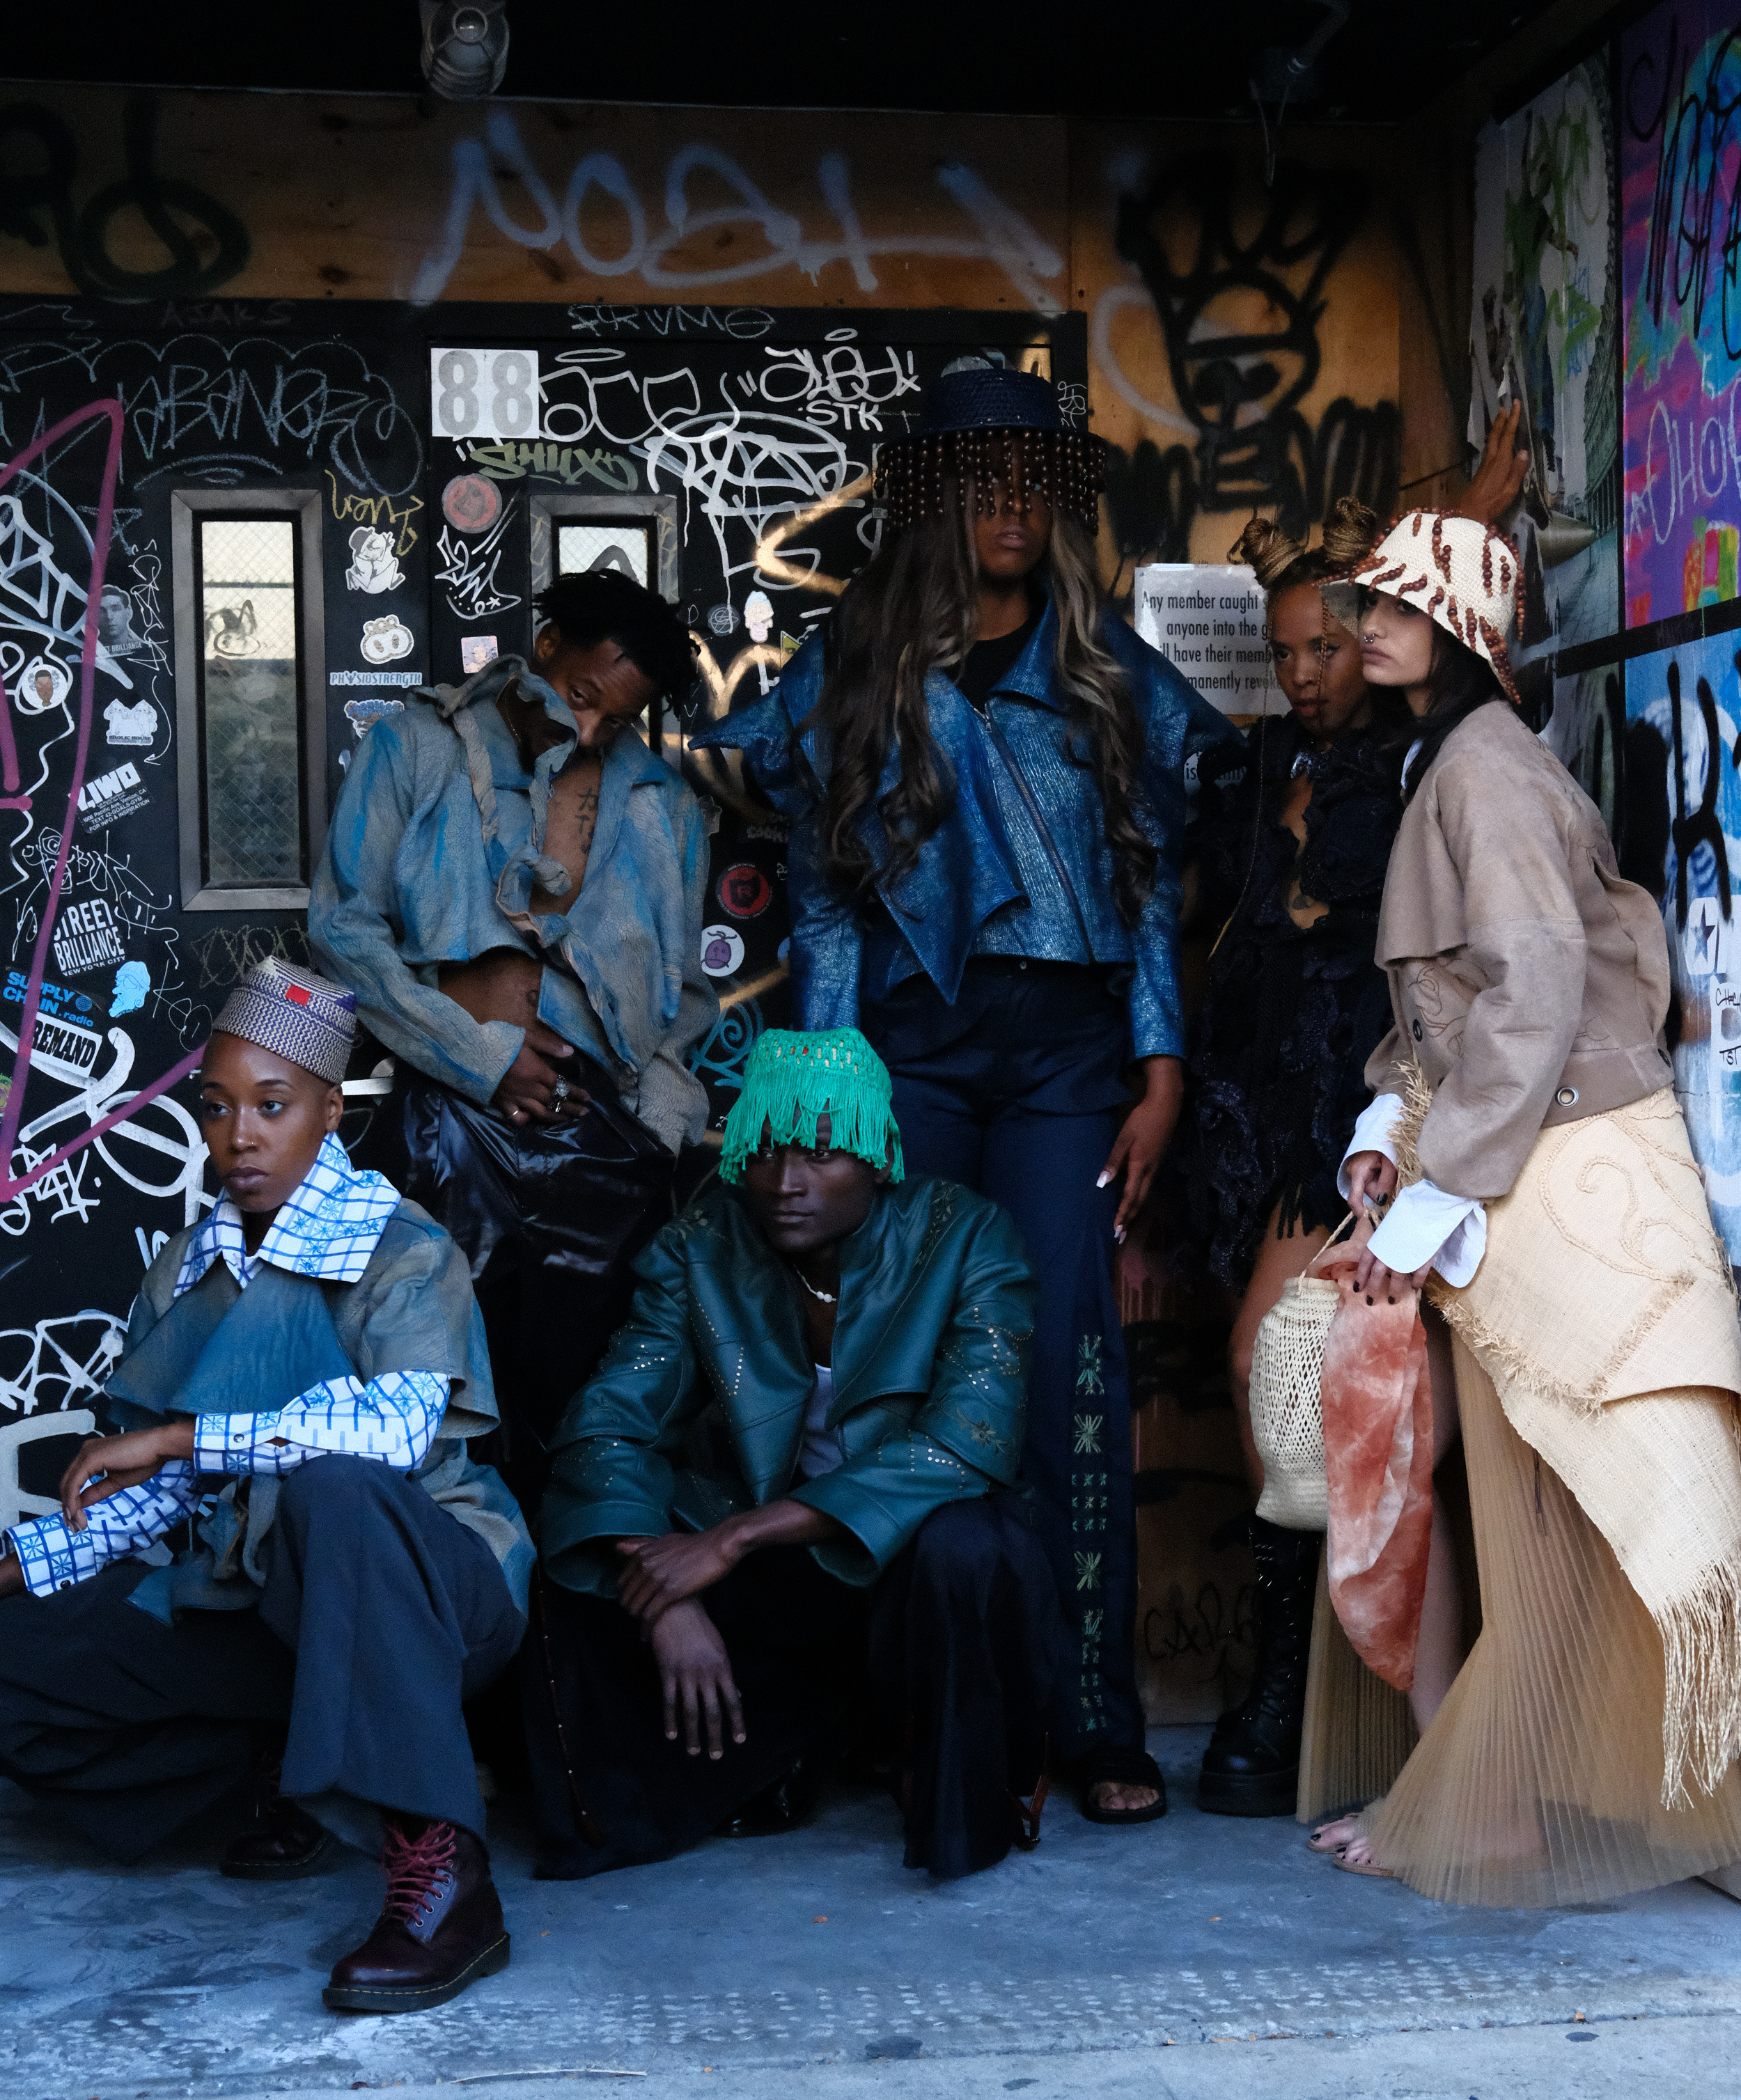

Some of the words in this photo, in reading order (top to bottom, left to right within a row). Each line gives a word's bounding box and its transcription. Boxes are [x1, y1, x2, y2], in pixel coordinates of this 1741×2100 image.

[1142, 591, 1163, 613] Any
[1168, 590, 1215, 609] member
[1220, 590, 1258, 613] caught
[1167, 622, 1209, 640] anyone
[1213, 619, 1235, 636] into
[1239, 618, 1257, 636] the
[1174, 643, 1201, 662] have
[1205, 643, 1232, 662] their
[1236, 645, 1272, 662] memb
[88, 823, 101, 832] FOR
[118, 799, 150, 817] INSPIRATION
[91, 815, 104, 824] TEXT
[54, 925, 125, 972] BRILLIANCE
[62, 967, 81, 977] NEW
[107, 955, 126, 965] CITY
[3, 986, 58, 1013] CHIN
